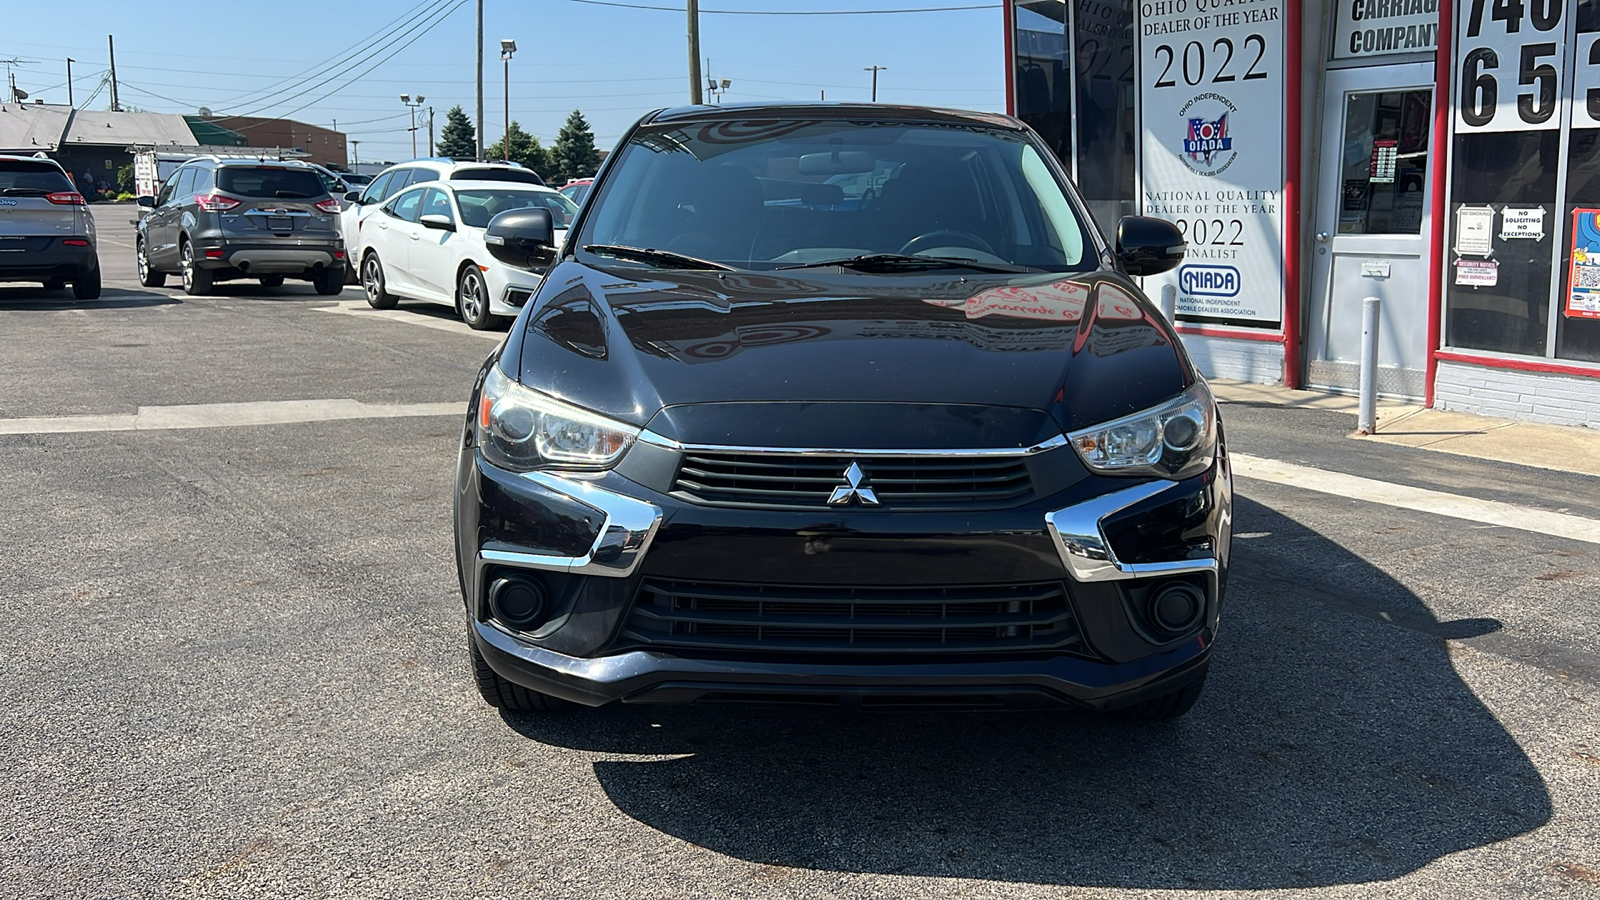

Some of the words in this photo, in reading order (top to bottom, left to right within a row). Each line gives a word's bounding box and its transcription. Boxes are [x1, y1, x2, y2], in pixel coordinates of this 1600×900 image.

[1142, 0, 1187, 18] OHIO
[1352, 0, 1439, 21] CARRIAG
[1144, 19, 1191, 36] DEALER
[1194, 16, 1210, 30] OF
[1213, 12, 1240, 27] THE
[1243, 7, 1279, 23] YEAR
[1154, 33, 1268, 89] 2022
[1179, 99, 1194, 117] OHIO
[1193, 92, 1238, 113] INDEPENDENT
[1189, 139, 1224, 152] OIADA
[1178, 153, 1199, 176] AUTOMOBILE
[1216, 150, 1238, 175] ASSOCIATION
[1145, 191, 1211, 202] NATIONAL
[1216, 190, 1278, 202] QUALITY
[1146, 205, 1190, 214] DEALER
[1195, 204, 1209, 214] OF
[1214, 204, 1238, 214] THE
[1243, 204, 1276, 214] YEAR
[1176, 218, 1244, 246] 2022
[1186, 249, 1238, 259] INALIST
[1183, 271, 1235, 291] NIADA
[1205, 298, 1241, 306] INDEPENDENT
[1220, 308, 1256, 316] ASSOCIATION
